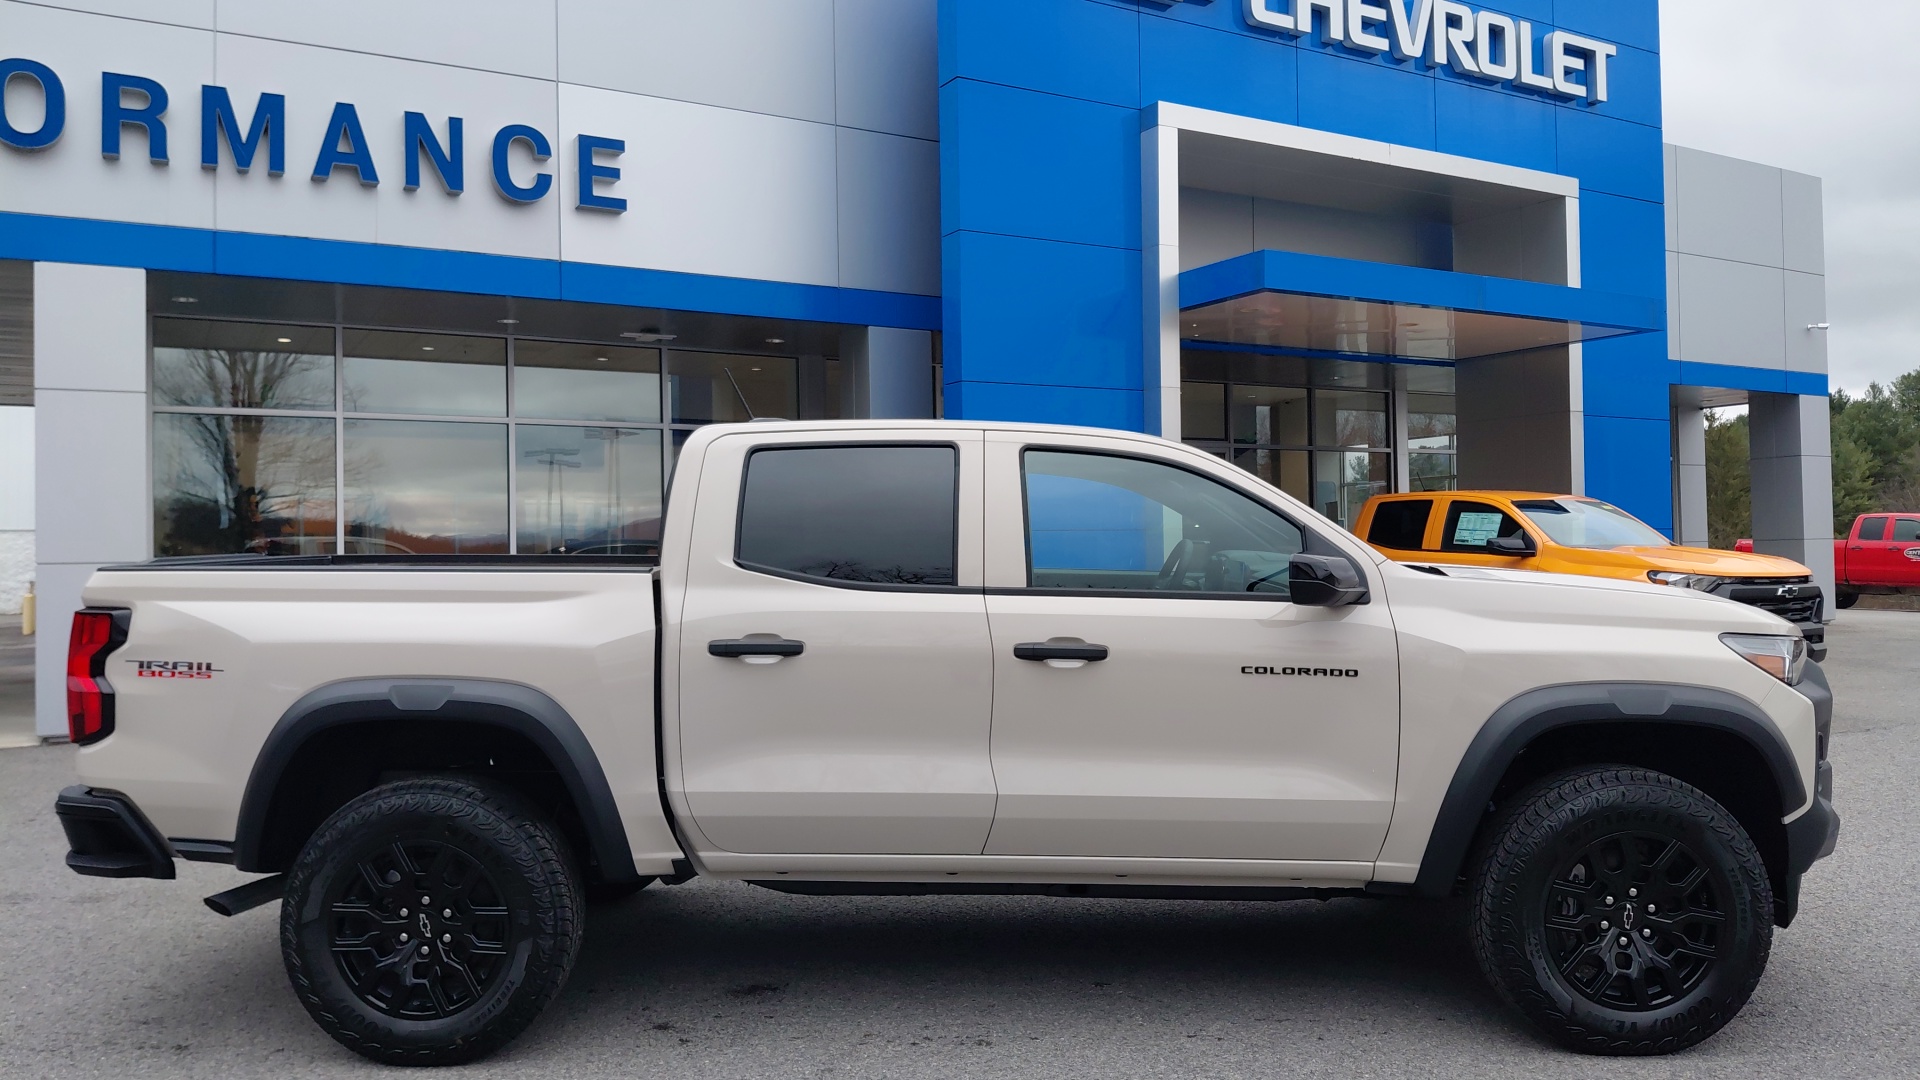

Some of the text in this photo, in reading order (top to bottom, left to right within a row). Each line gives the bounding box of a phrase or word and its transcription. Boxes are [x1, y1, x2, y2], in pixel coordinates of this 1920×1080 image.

[0, 57, 627, 214] ORMANCE
[125, 660, 224, 672] TRAIL
[1240, 665, 1359, 678] COLORADO
[138, 670, 212, 679] BOSS
